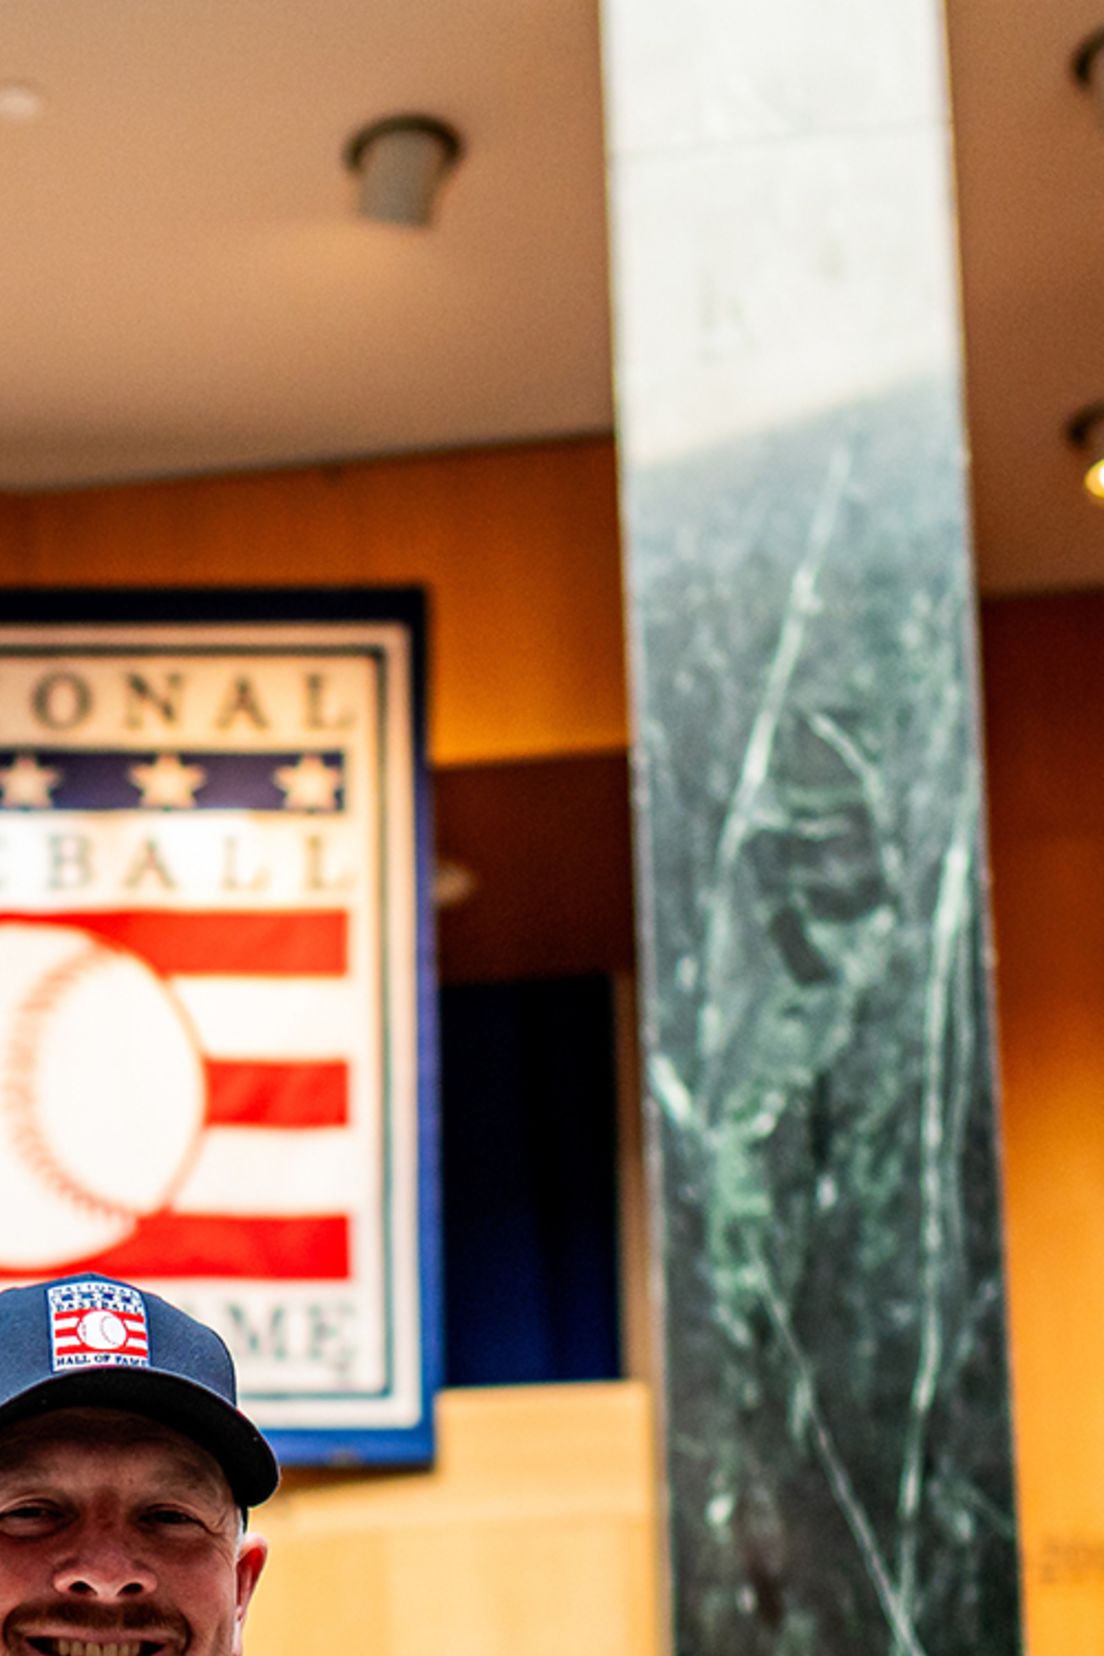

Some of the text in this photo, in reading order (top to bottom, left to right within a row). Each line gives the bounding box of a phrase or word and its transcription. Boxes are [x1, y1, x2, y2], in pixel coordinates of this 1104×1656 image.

[55, 1300, 144, 1316] BASEBALL
[226, 1302, 357, 1363] ME
[57, 1353, 147, 1367] HALL OF FAME
